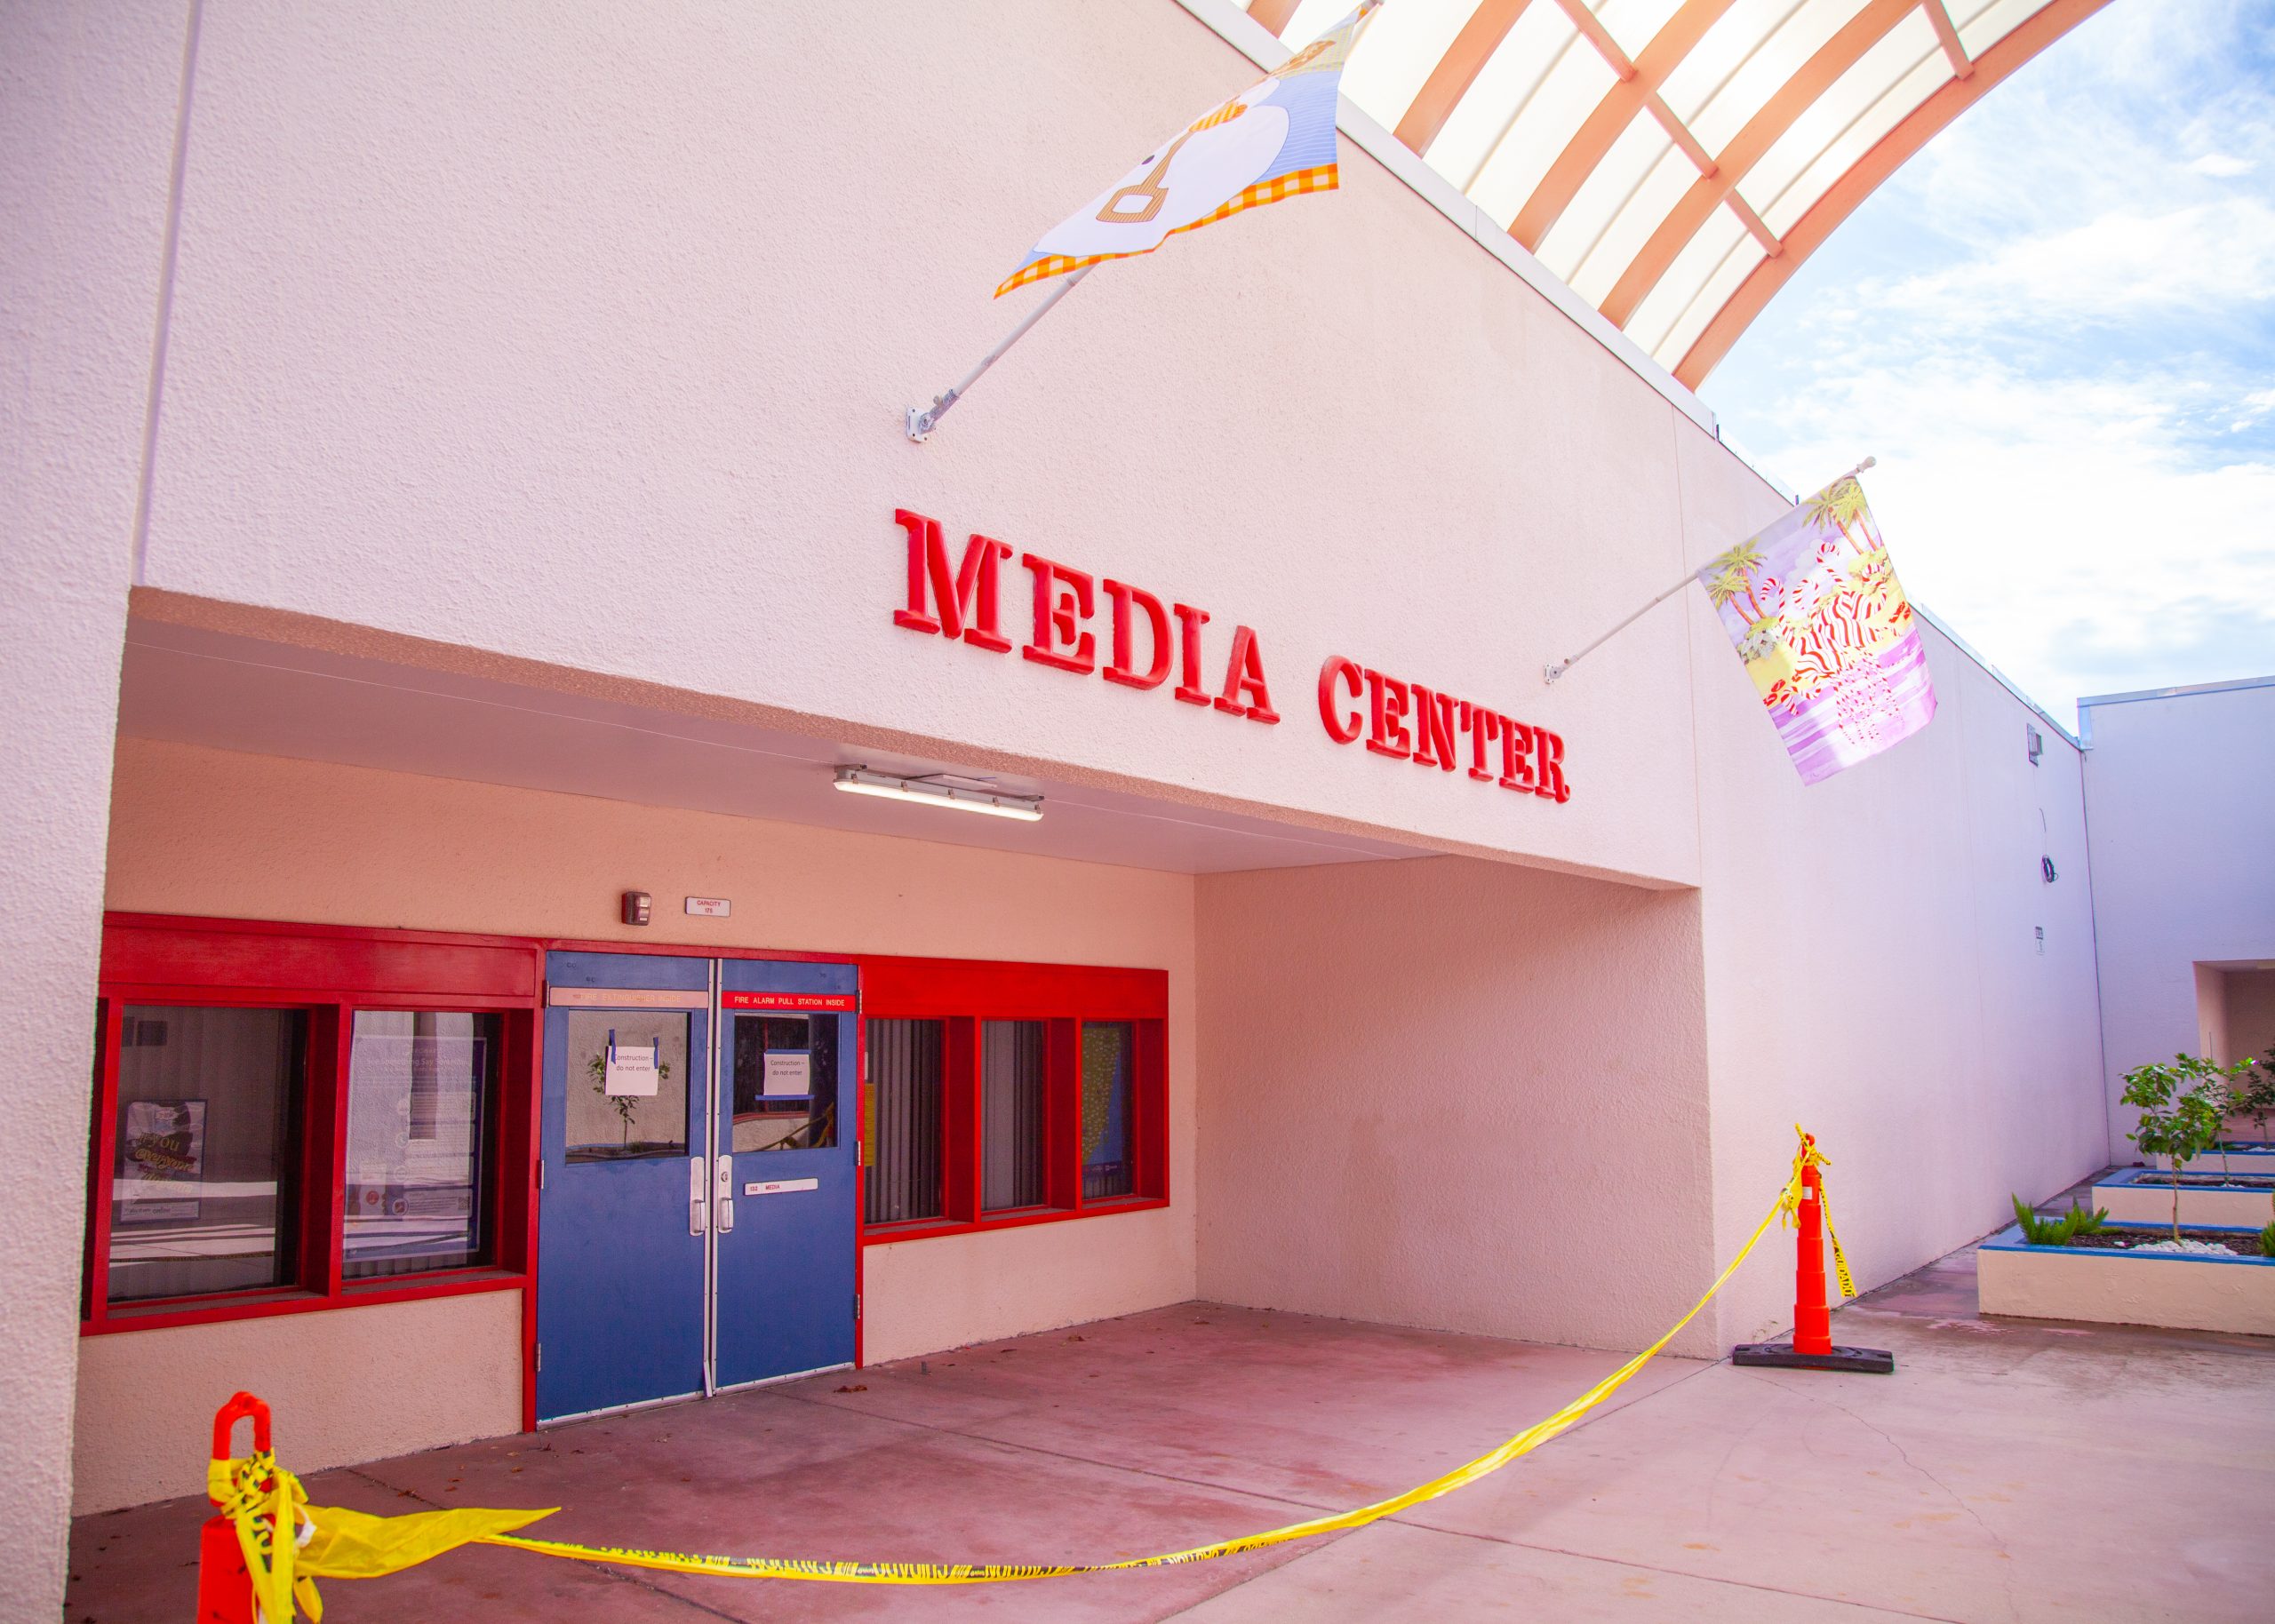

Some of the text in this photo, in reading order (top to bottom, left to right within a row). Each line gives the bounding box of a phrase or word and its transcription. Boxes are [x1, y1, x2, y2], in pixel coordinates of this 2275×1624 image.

[892, 507, 1571, 804] MEDIA CENTER
[659, 994, 682, 1003] INSIDE
